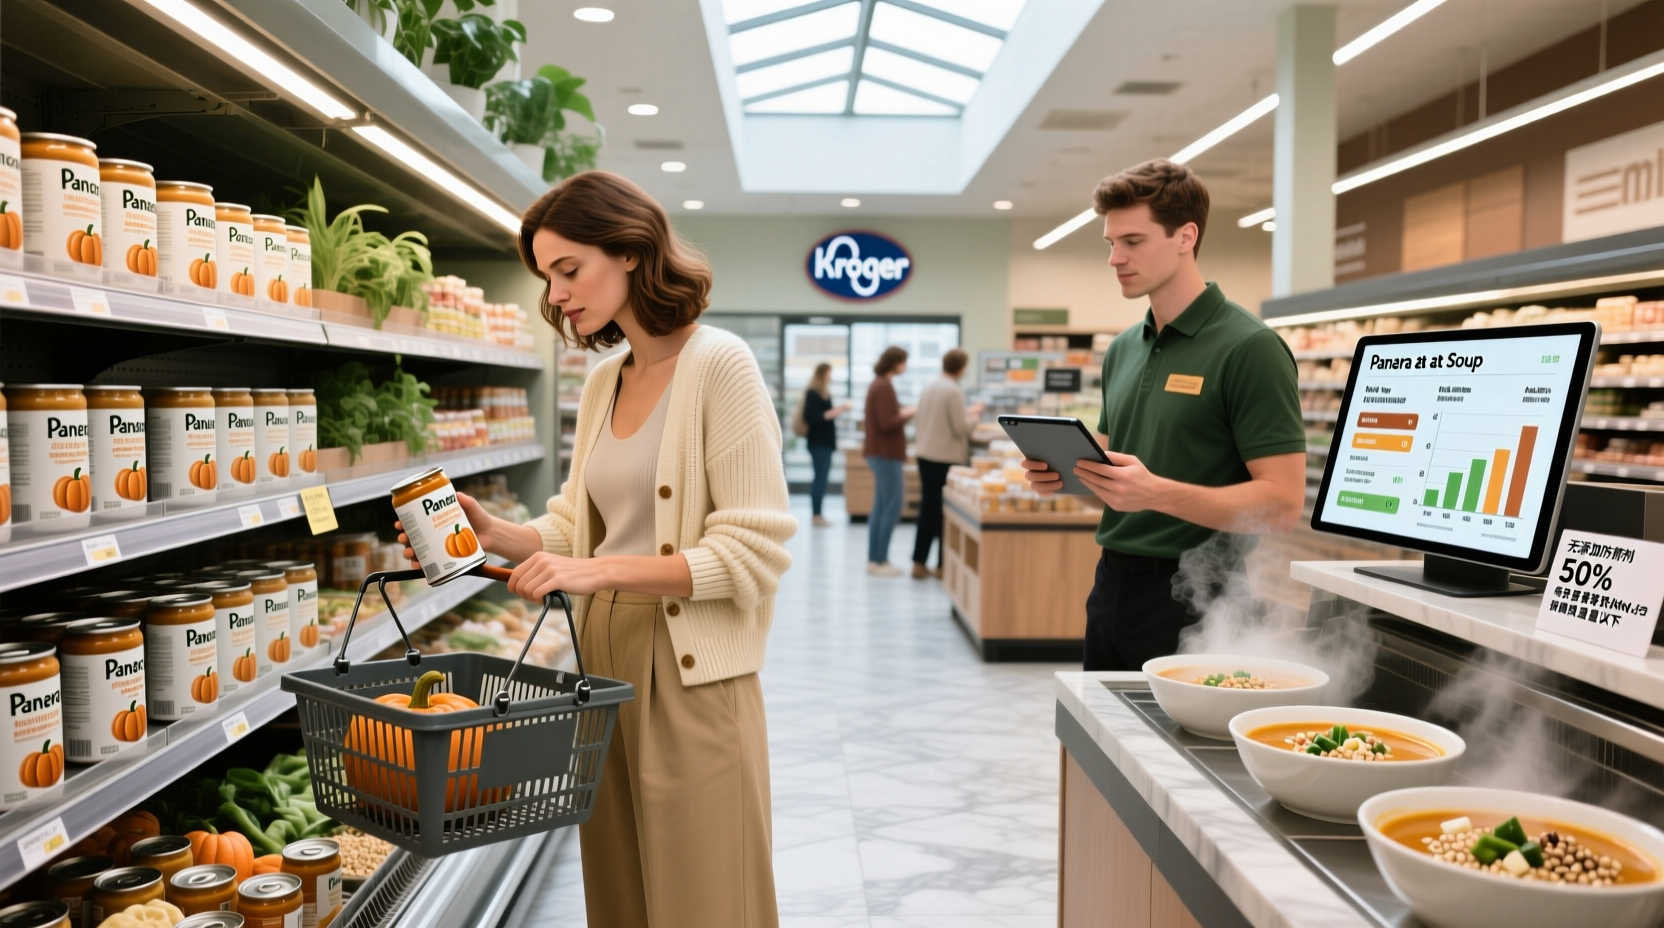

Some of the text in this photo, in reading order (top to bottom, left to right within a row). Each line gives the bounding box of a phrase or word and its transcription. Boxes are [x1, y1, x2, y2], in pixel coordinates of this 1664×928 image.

[814, 235, 910, 297] Kroger
[1429, 354, 1444, 369] at
[1446, 352, 1484, 373] Soup
[1559, 558, 1612, 591] 50%
